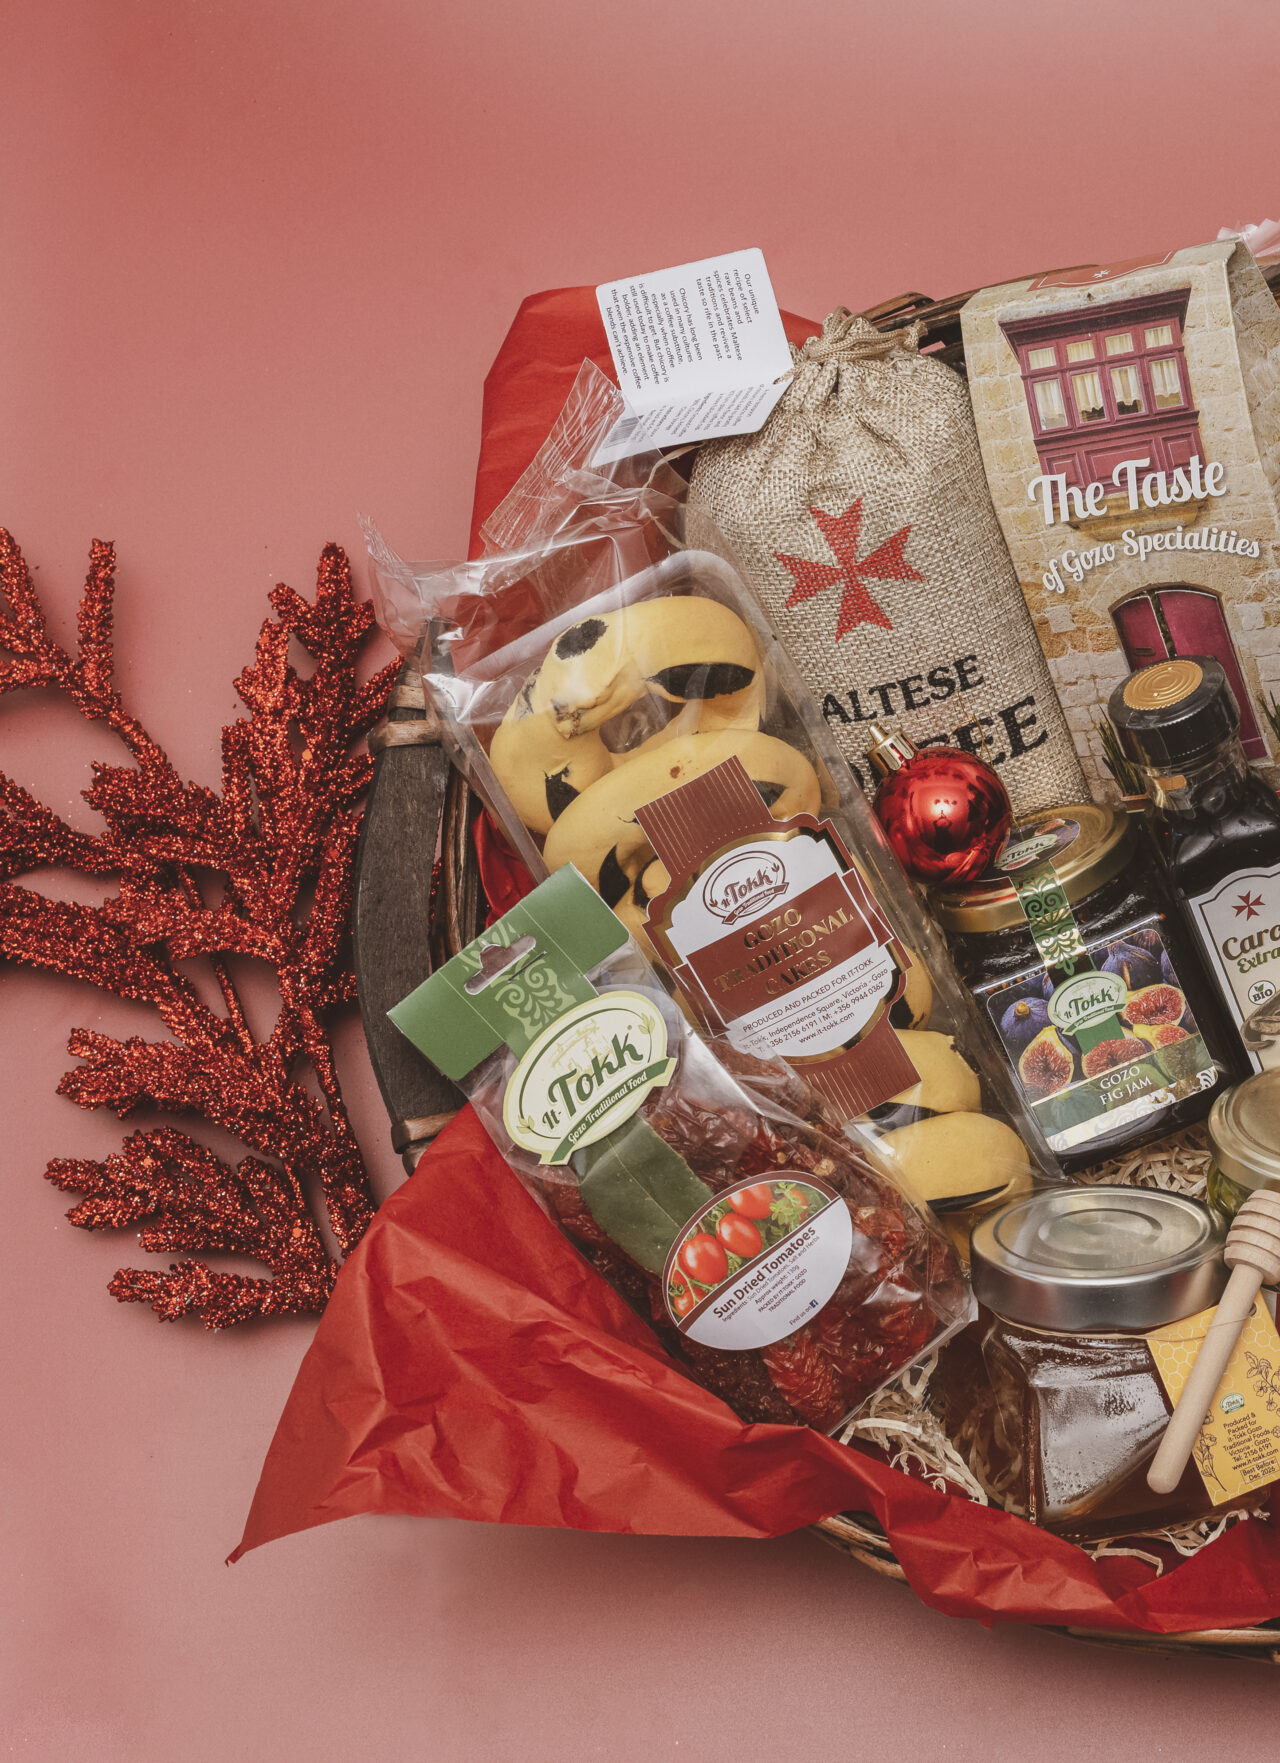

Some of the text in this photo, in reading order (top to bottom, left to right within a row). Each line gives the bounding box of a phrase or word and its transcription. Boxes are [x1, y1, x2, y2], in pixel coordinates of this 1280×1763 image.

[705, 276, 719, 312] traditions
[724, 272, 744, 325] raw beans and
[733, 269, 753, 324] recipe of select
[744, 273, 760, 315] Our unique
[696, 278, 723, 360] taste so rife in the past.
[713, 270, 743, 361] spices celebrates Maltese
[715, 312, 725, 327] and
[719, 327, 731, 353] revives
[1027, 455, 1227, 525] The Taste
[1042, 527, 1260, 594] of Gozo Specialities
[823, 654, 985, 724] ALTESE
[713, 907, 854, 993] TRADITIONAL
[743, 908, 802, 950] GOZO
[765, 949, 832, 995] CAKES
[742, 957, 873, 1033] PRODUCED AND PACKED FOR IT-TOKK
[768, 1011, 816, 1037] Independence
[816, 998, 842, 1013] Square,
[841, 982, 867, 998] Victoria
[871, 968, 888, 981] Gozo
[783, 1028, 800, 1040] 2156
[801, 1019, 817, 1032] 6191
[822, 1013, 832, 1021] M:
[833, 1002, 850, 1014] +356
[850, 991, 868, 1005] 9944
[867, 981, 884, 994] 0362
[1253, 987, 1273, 1003] BIO
[798, 1012, 854, 1043] www.it-tokk.com
[1099, 1065, 1141, 1091] GOZO
[1099, 1075, 1152, 1106] FIG JAM
[568, 1071, 649, 1145] Gozo Traditional Food
[713, 1227, 815, 1318] Sun Dried Tomatoes
[720, 1301, 748, 1323] Ingredients:
[747, 1292, 758, 1302] Sun
[755, 1280, 770, 1294] Dried
[788, 1255, 799, 1265] Salt
[797, 1247, 808, 1258] and
[754, 1289, 772, 1305] Approx
[771, 1275, 789, 1291] weight:
[1223, 1414, 1250, 1429] Produced
[1227, 1422, 1248, 1435] Packed
[1222, 1435, 1252, 1451] Traditional
[1232, 1442, 1272, 1462] Tel: 2156 6191
[1232, 1448, 1278, 1470] www.it-tokk.com
[1242, 1467, 1255, 1476] Best
[1248, 1473, 1260, 1481] Dec
